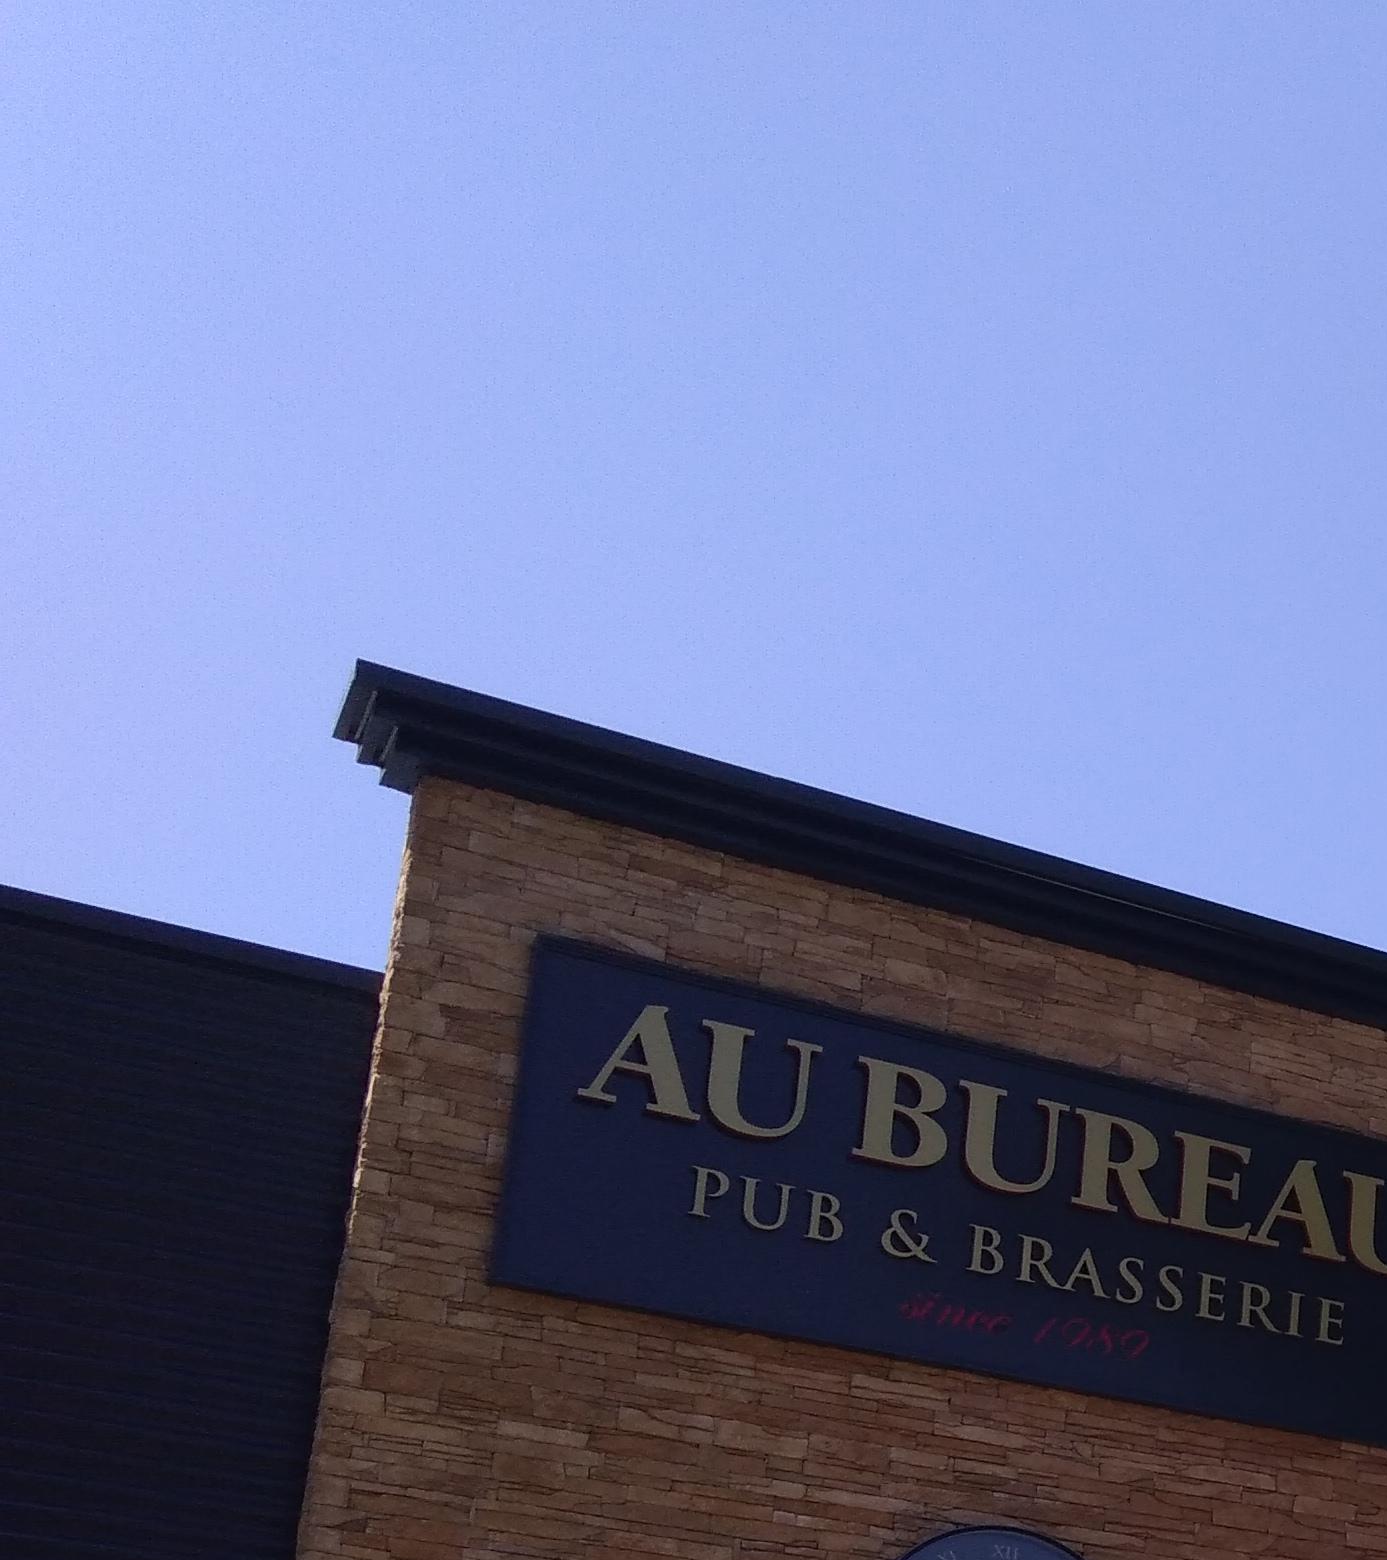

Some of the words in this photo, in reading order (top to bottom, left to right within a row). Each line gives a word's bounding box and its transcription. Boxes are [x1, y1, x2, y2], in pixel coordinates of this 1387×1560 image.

[576, 1004, 823, 1139] AU
[687, 1165, 845, 1243] PUB
[880, 1208, 939, 1264] &
[966, 1224, 1346, 1346] BRASSERIE
[992, 1544, 1018, 1560] XII
